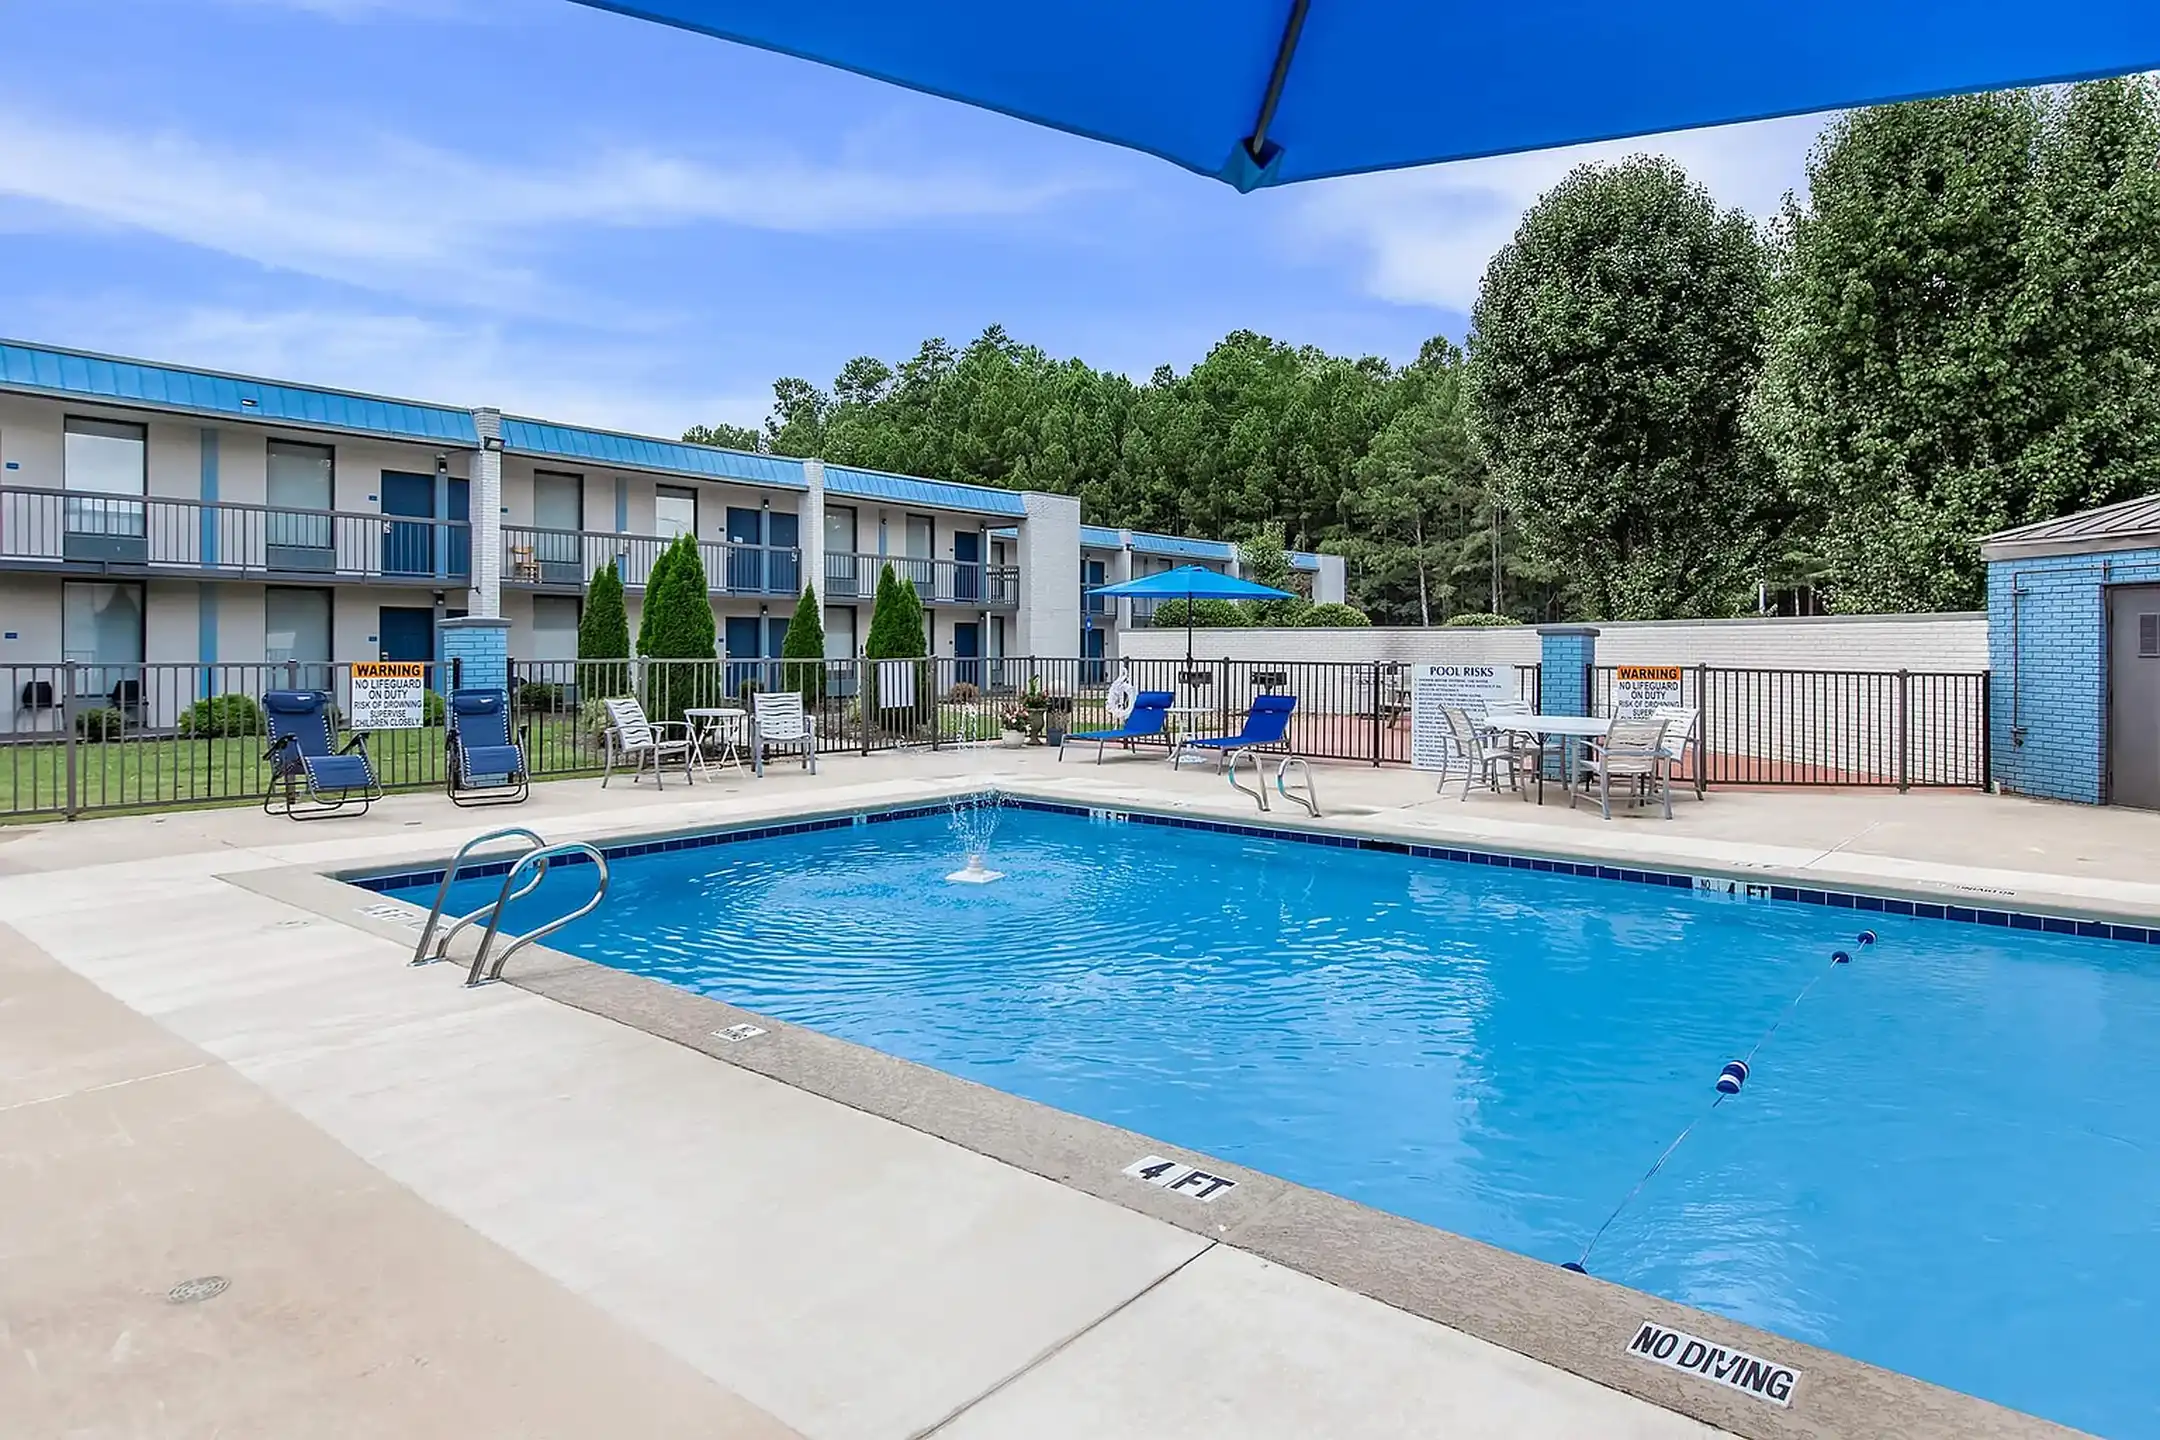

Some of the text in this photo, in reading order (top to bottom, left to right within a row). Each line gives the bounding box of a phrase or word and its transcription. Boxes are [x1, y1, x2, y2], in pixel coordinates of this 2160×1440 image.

[356, 664, 420, 677] WARNING
[1429, 666, 1494, 677] POOL RISKS
[1620, 668, 1677, 680] WARNING
[355, 679, 421, 689] NO LIFEGUARD
[1619, 681, 1679, 691] NO LIFEGUARD
[368, 689, 408, 700] ON DUTY
[1630, 691, 1666, 700] ON DUTY
[354, 700, 422, 710] RISK OF DROWNING
[1619, 700, 1634, 708] RISK
[369, 709, 406, 719] SUPERVISE
[355, 718, 389, 728] CHILDREN
[1745, 884, 1769, 898] FT
[1139, 1161, 1236, 1198] 4 FT
[1630, 1325, 1794, 1401] NO DIVING
